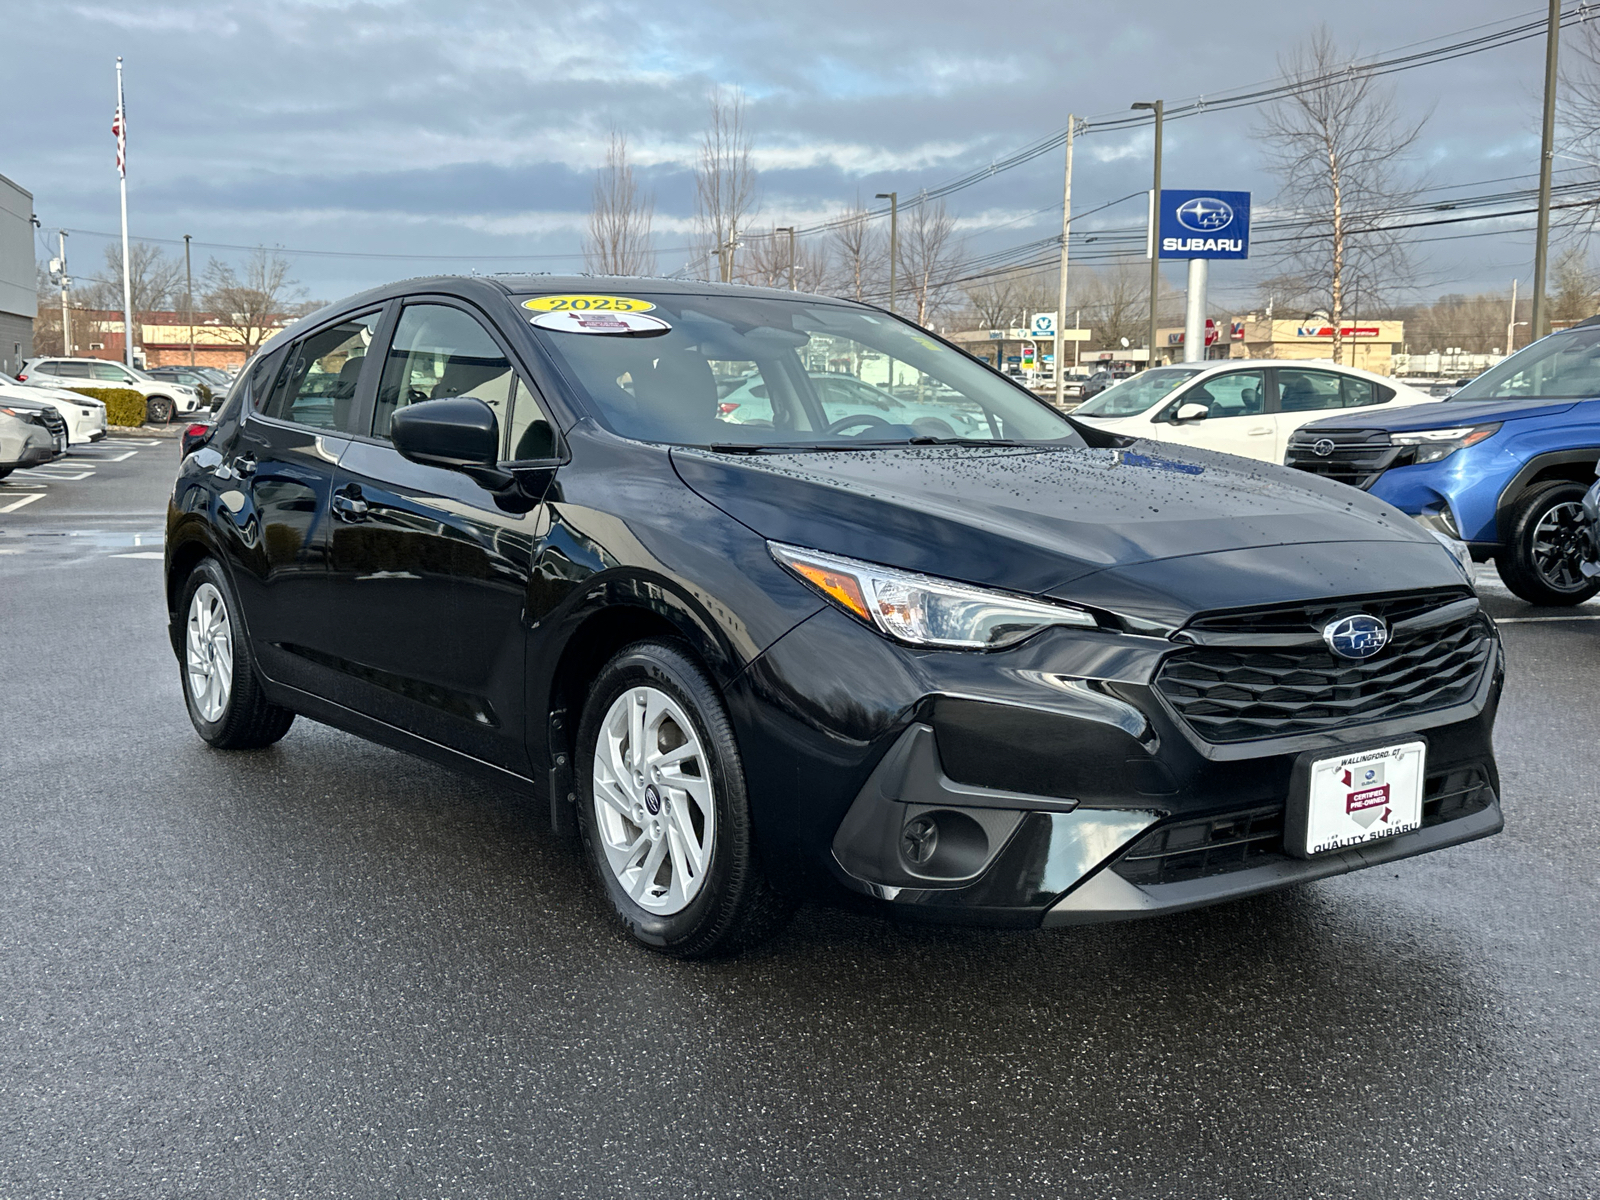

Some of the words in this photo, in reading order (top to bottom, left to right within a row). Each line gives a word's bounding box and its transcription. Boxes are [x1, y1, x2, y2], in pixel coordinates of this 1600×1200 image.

[1163, 238, 1242, 251] SUBARU
[549, 299, 633, 311] 2025
[1392, 748, 1401, 756] CT
[1353, 789, 1384, 801] CERTIFIED
[1350, 796, 1386, 809] PRE-OWNED
[1313, 834, 1365, 854] QUALITY
[1369, 822, 1418, 840] SUBARU
